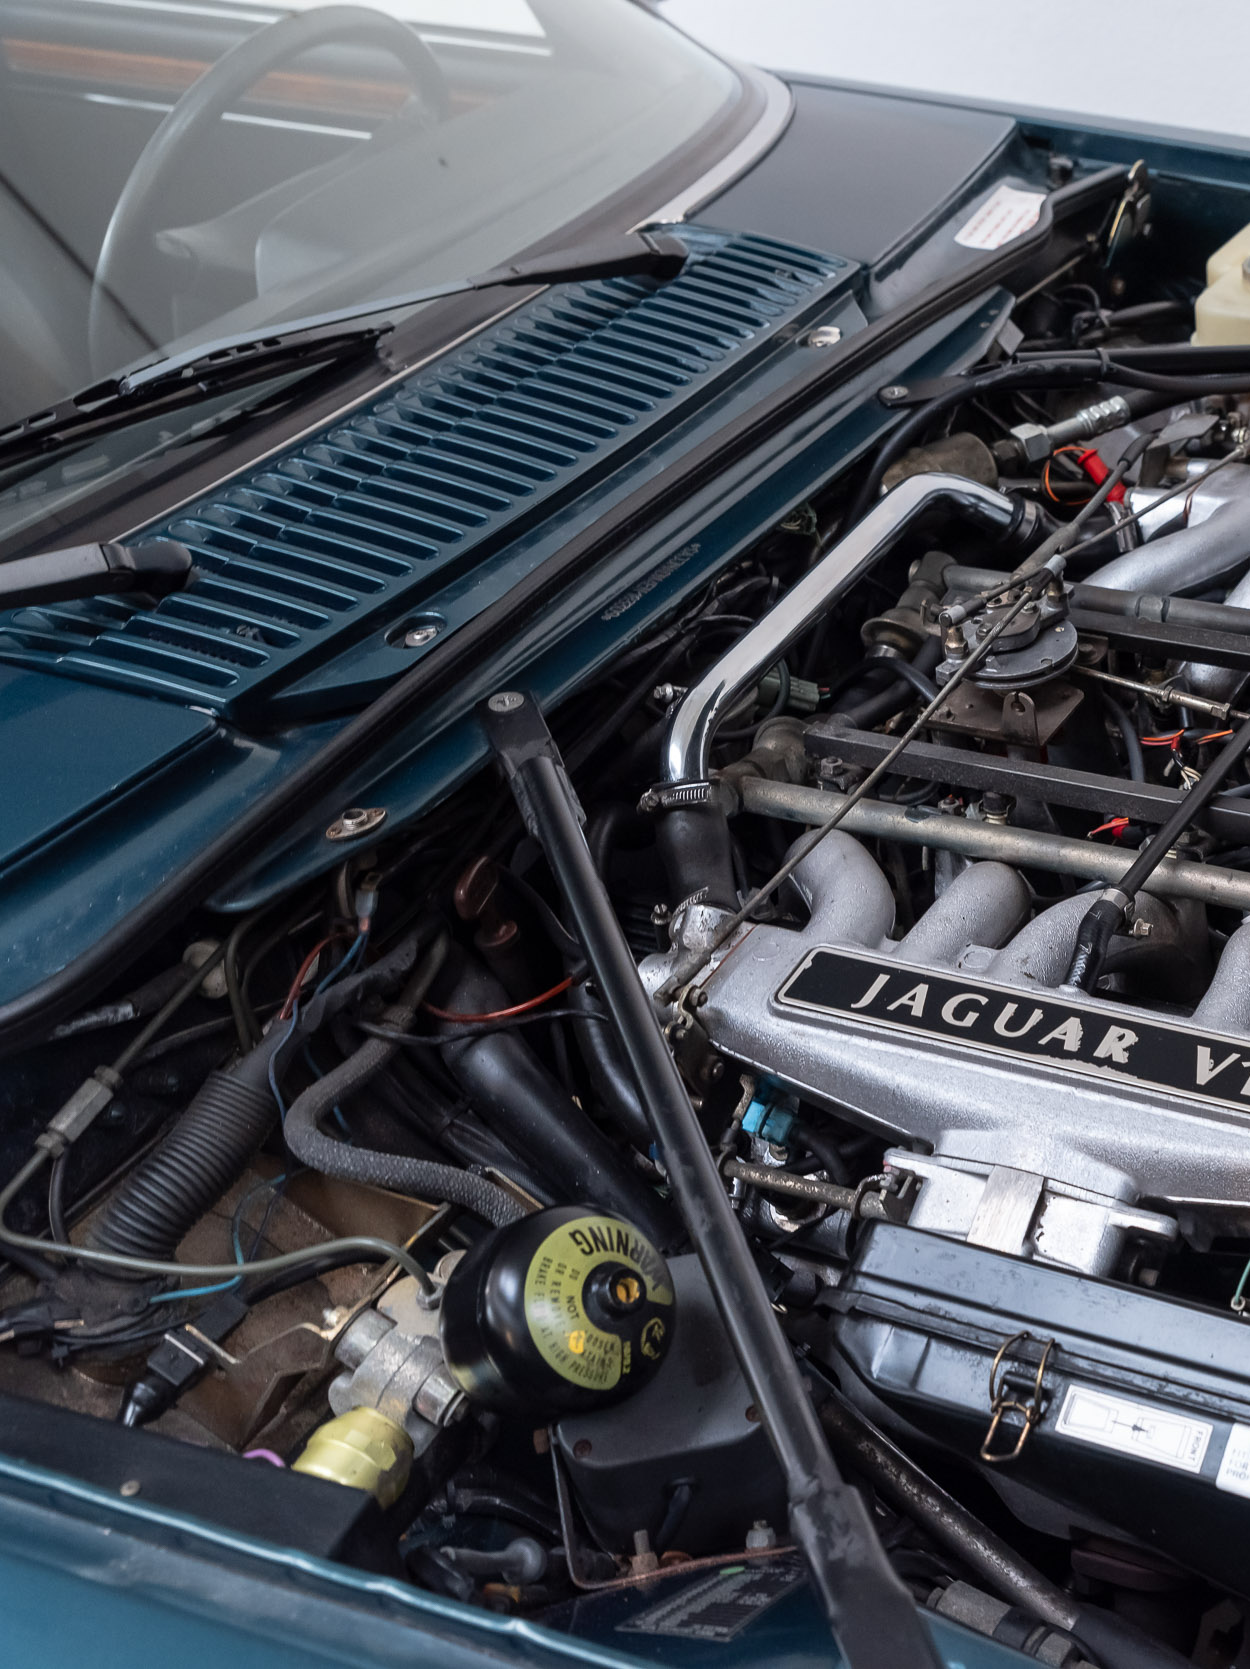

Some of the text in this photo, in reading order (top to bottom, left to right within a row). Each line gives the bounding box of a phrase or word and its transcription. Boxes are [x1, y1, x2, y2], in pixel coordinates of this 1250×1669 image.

[851, 973, 1137, 1065] JAGUAR
[534, 1256, 553, 1286] BRAKE
[568, 1226, 666, 1292] WARNING
[566, 1295, 581, 1320] NOT
[540, 1326, 552, 1339] AT
[549, 1340, 568, 1364] HIGH
[1187, 1429, 1204, 1462] FRONT
[1227, 1457, 1249, 1471] FOR
